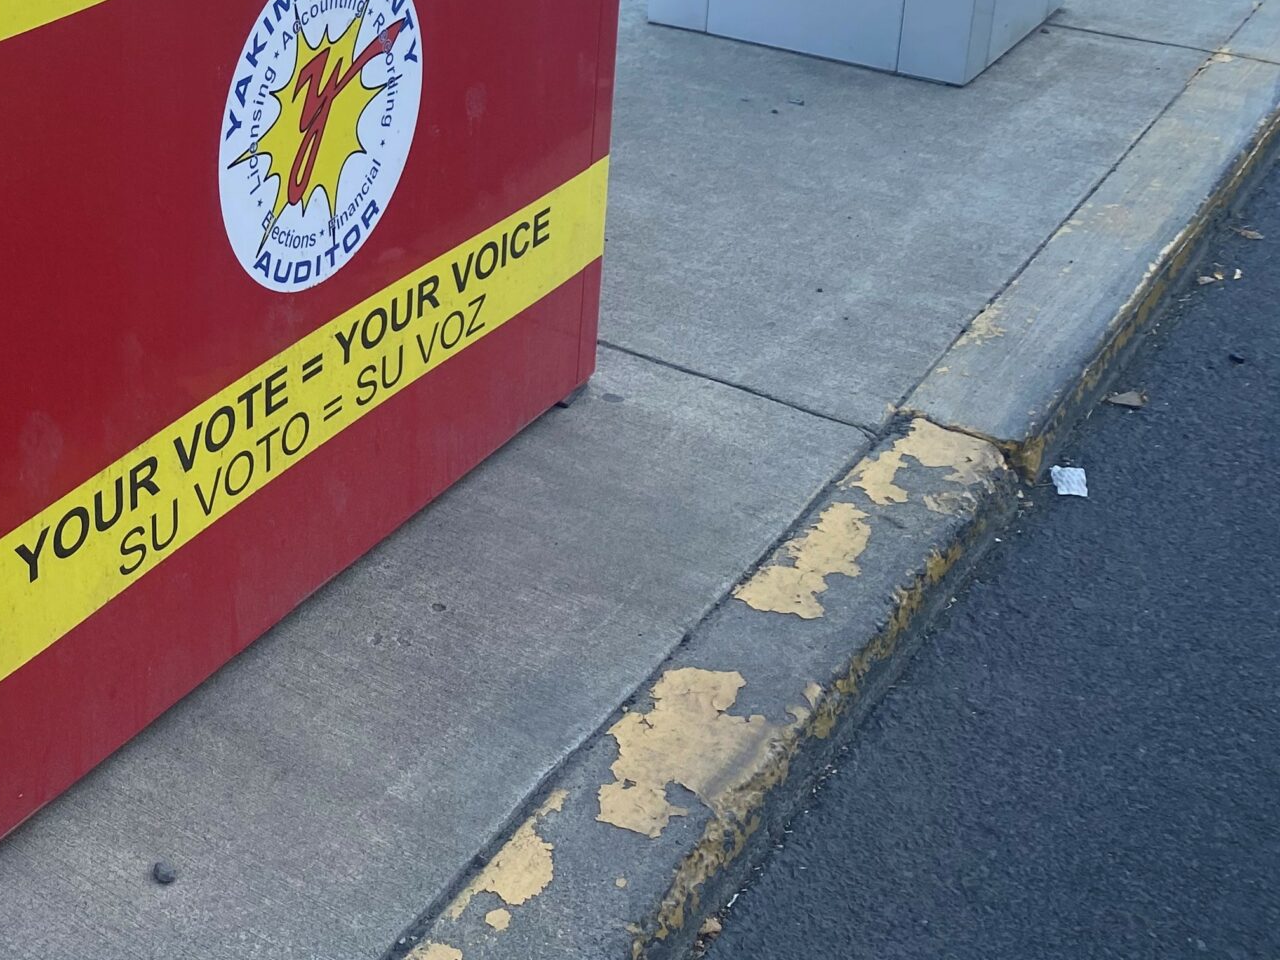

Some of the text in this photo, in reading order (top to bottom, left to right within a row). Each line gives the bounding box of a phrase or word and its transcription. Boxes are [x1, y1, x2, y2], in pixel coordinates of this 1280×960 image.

[249, 65, 277, 195] Licensing
[372, 12, 399, 128] Recording
[253, 198, 380, 284] AUDITOR
[328, 158, 382, 237] Financial
[13, 207, 552, 584] YOUR VOTE = YOUR VOICE
[119, 293, 487, 576] SU VOTO = SU VOZ
